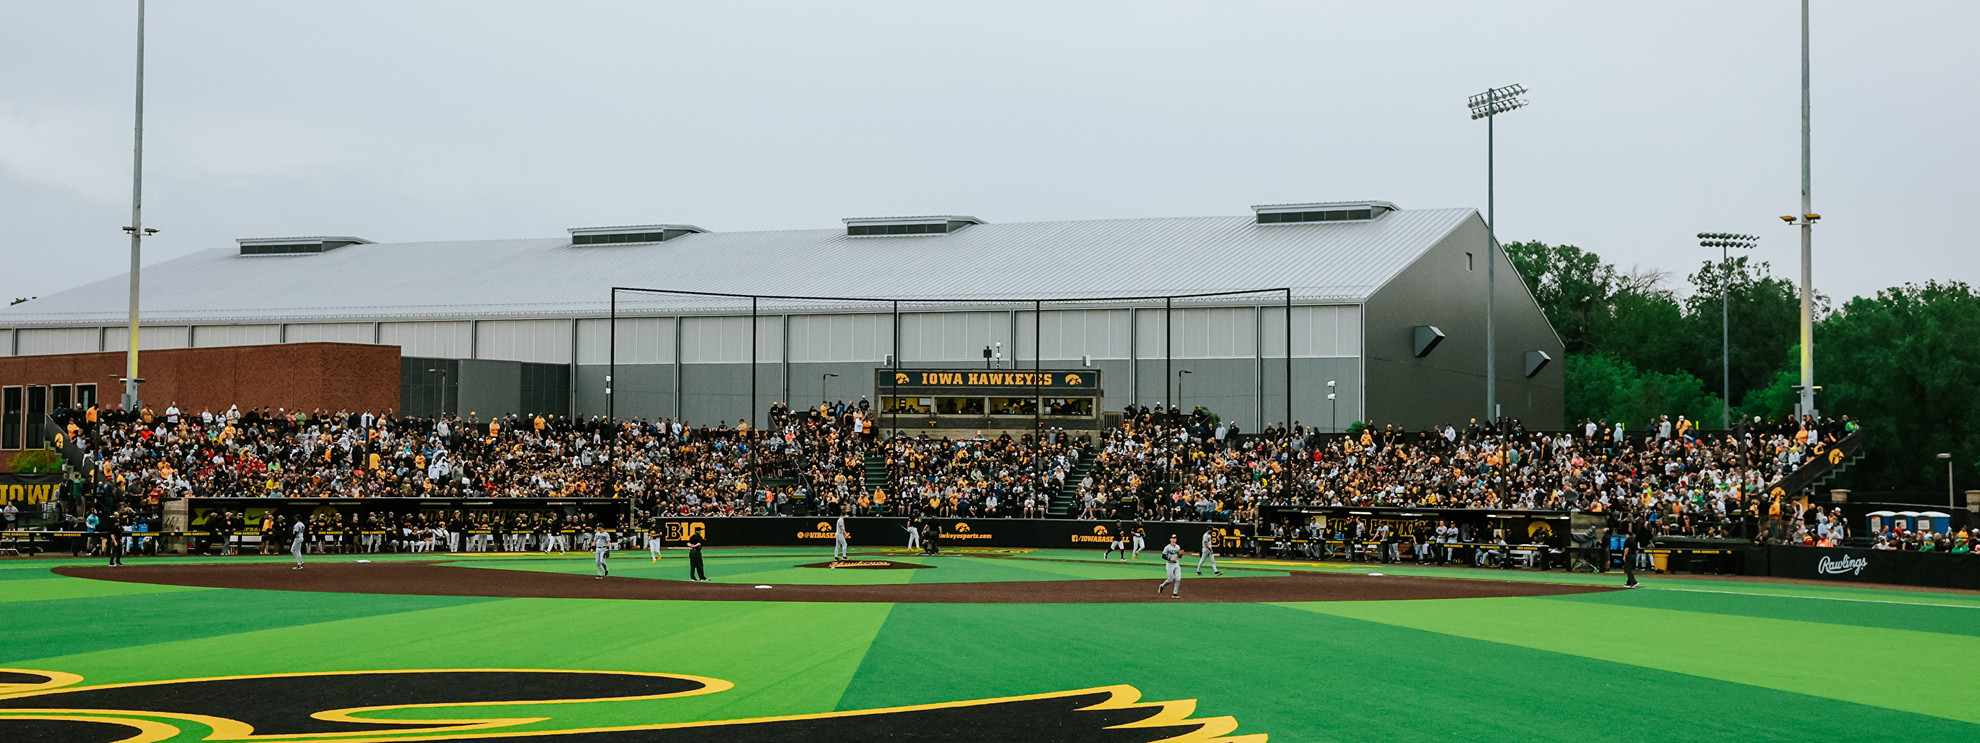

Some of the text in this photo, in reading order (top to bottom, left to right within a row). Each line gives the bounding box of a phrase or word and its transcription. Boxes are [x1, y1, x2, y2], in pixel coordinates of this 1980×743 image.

[921, 372, 1053, 386] IOWA HAWKEYES
[1818, 554, 1868, 576] Rawlings
